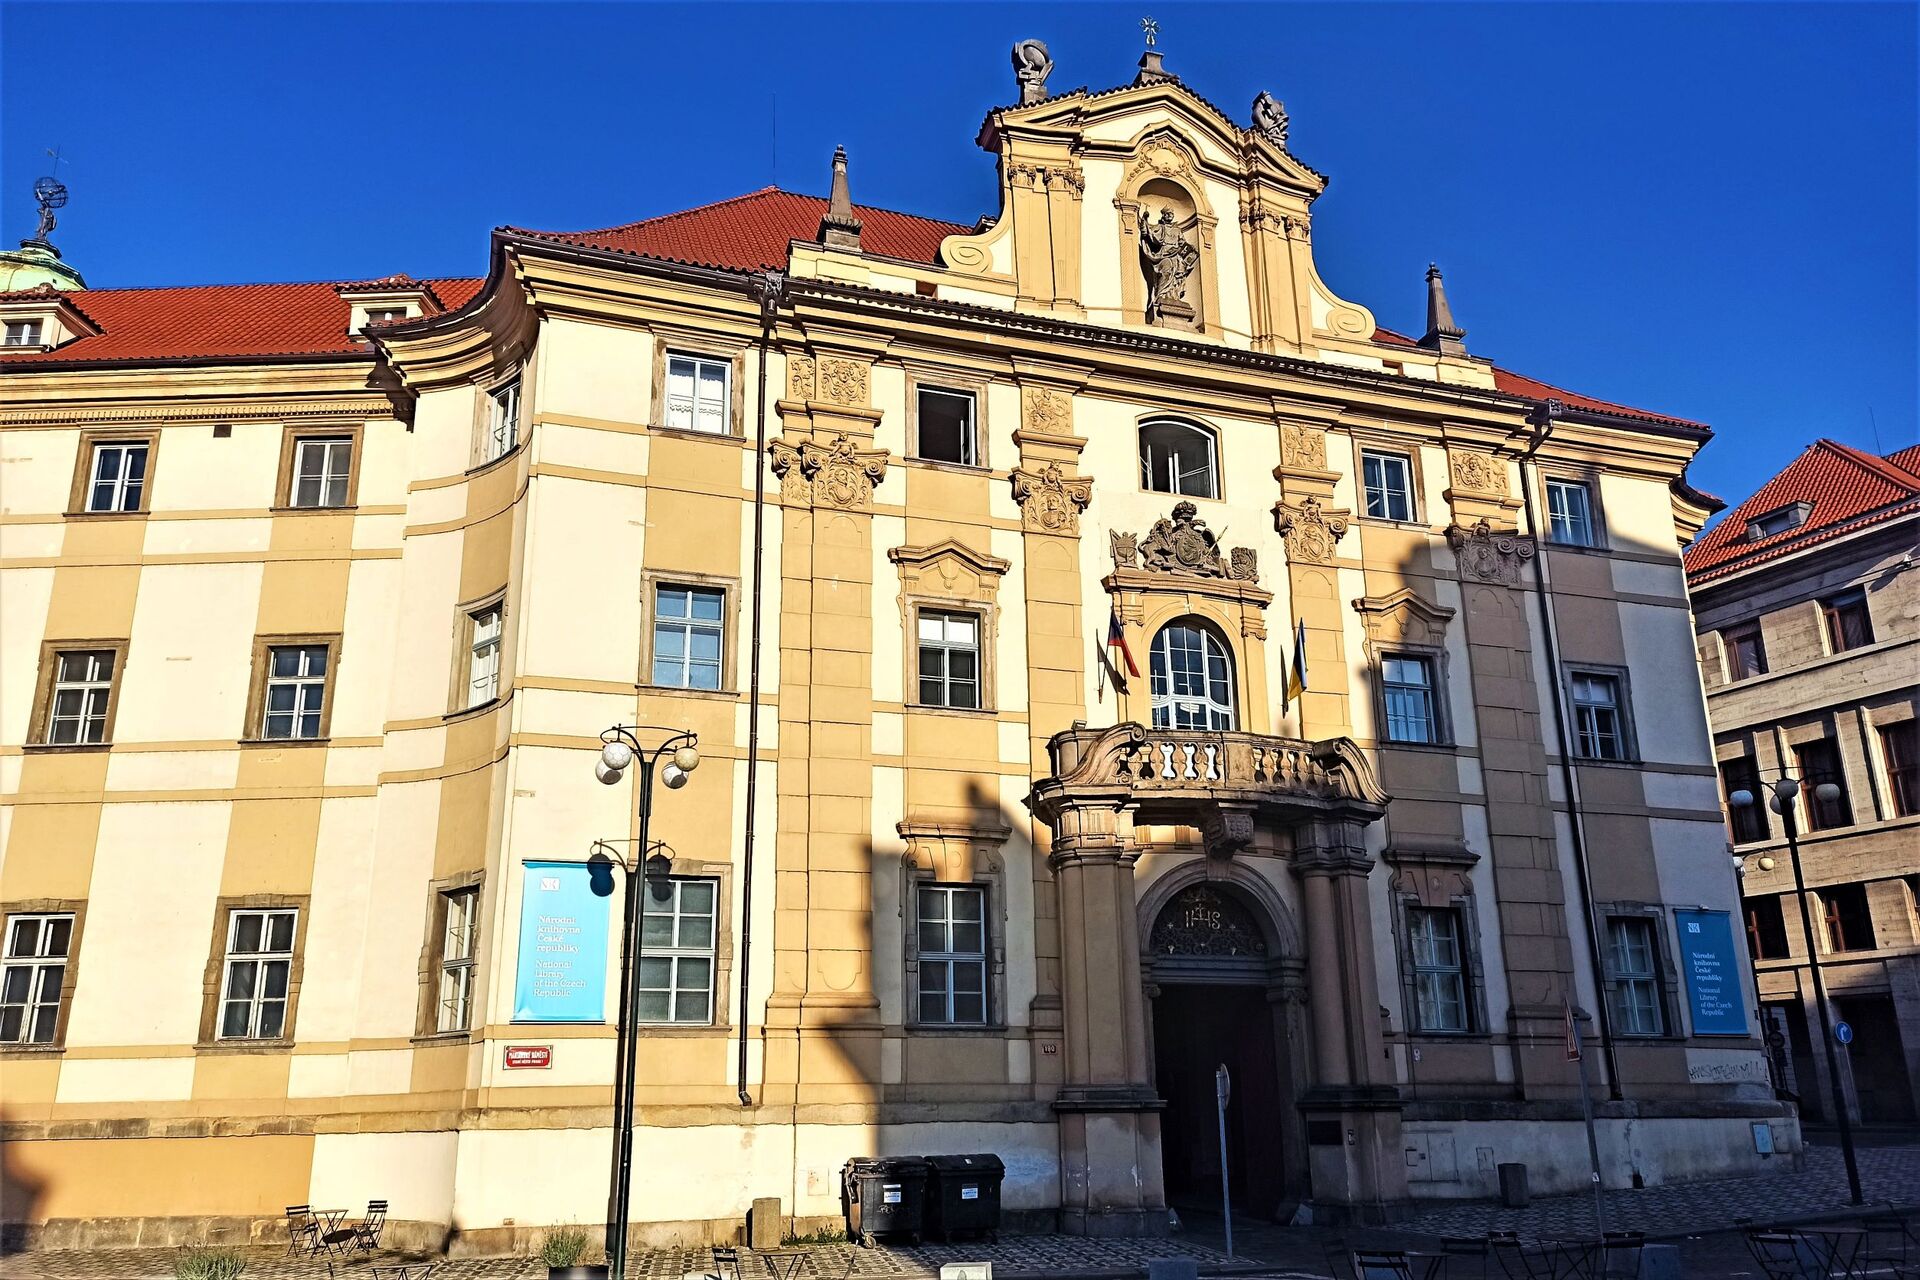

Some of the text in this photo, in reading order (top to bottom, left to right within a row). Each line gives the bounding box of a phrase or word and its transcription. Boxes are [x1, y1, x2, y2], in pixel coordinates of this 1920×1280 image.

[538, 914, 576, 924] Národní
[537, 925, 582, 933] knihovna
[537, 933, 564, 943] České
[536, 944, 579, 954] republiky
[536, 960, 573, 969] National
[535, 970, 563, 979] Library
[534, 980, 587, 988] of the Czech
[533, 989, 572, 998] Republic
